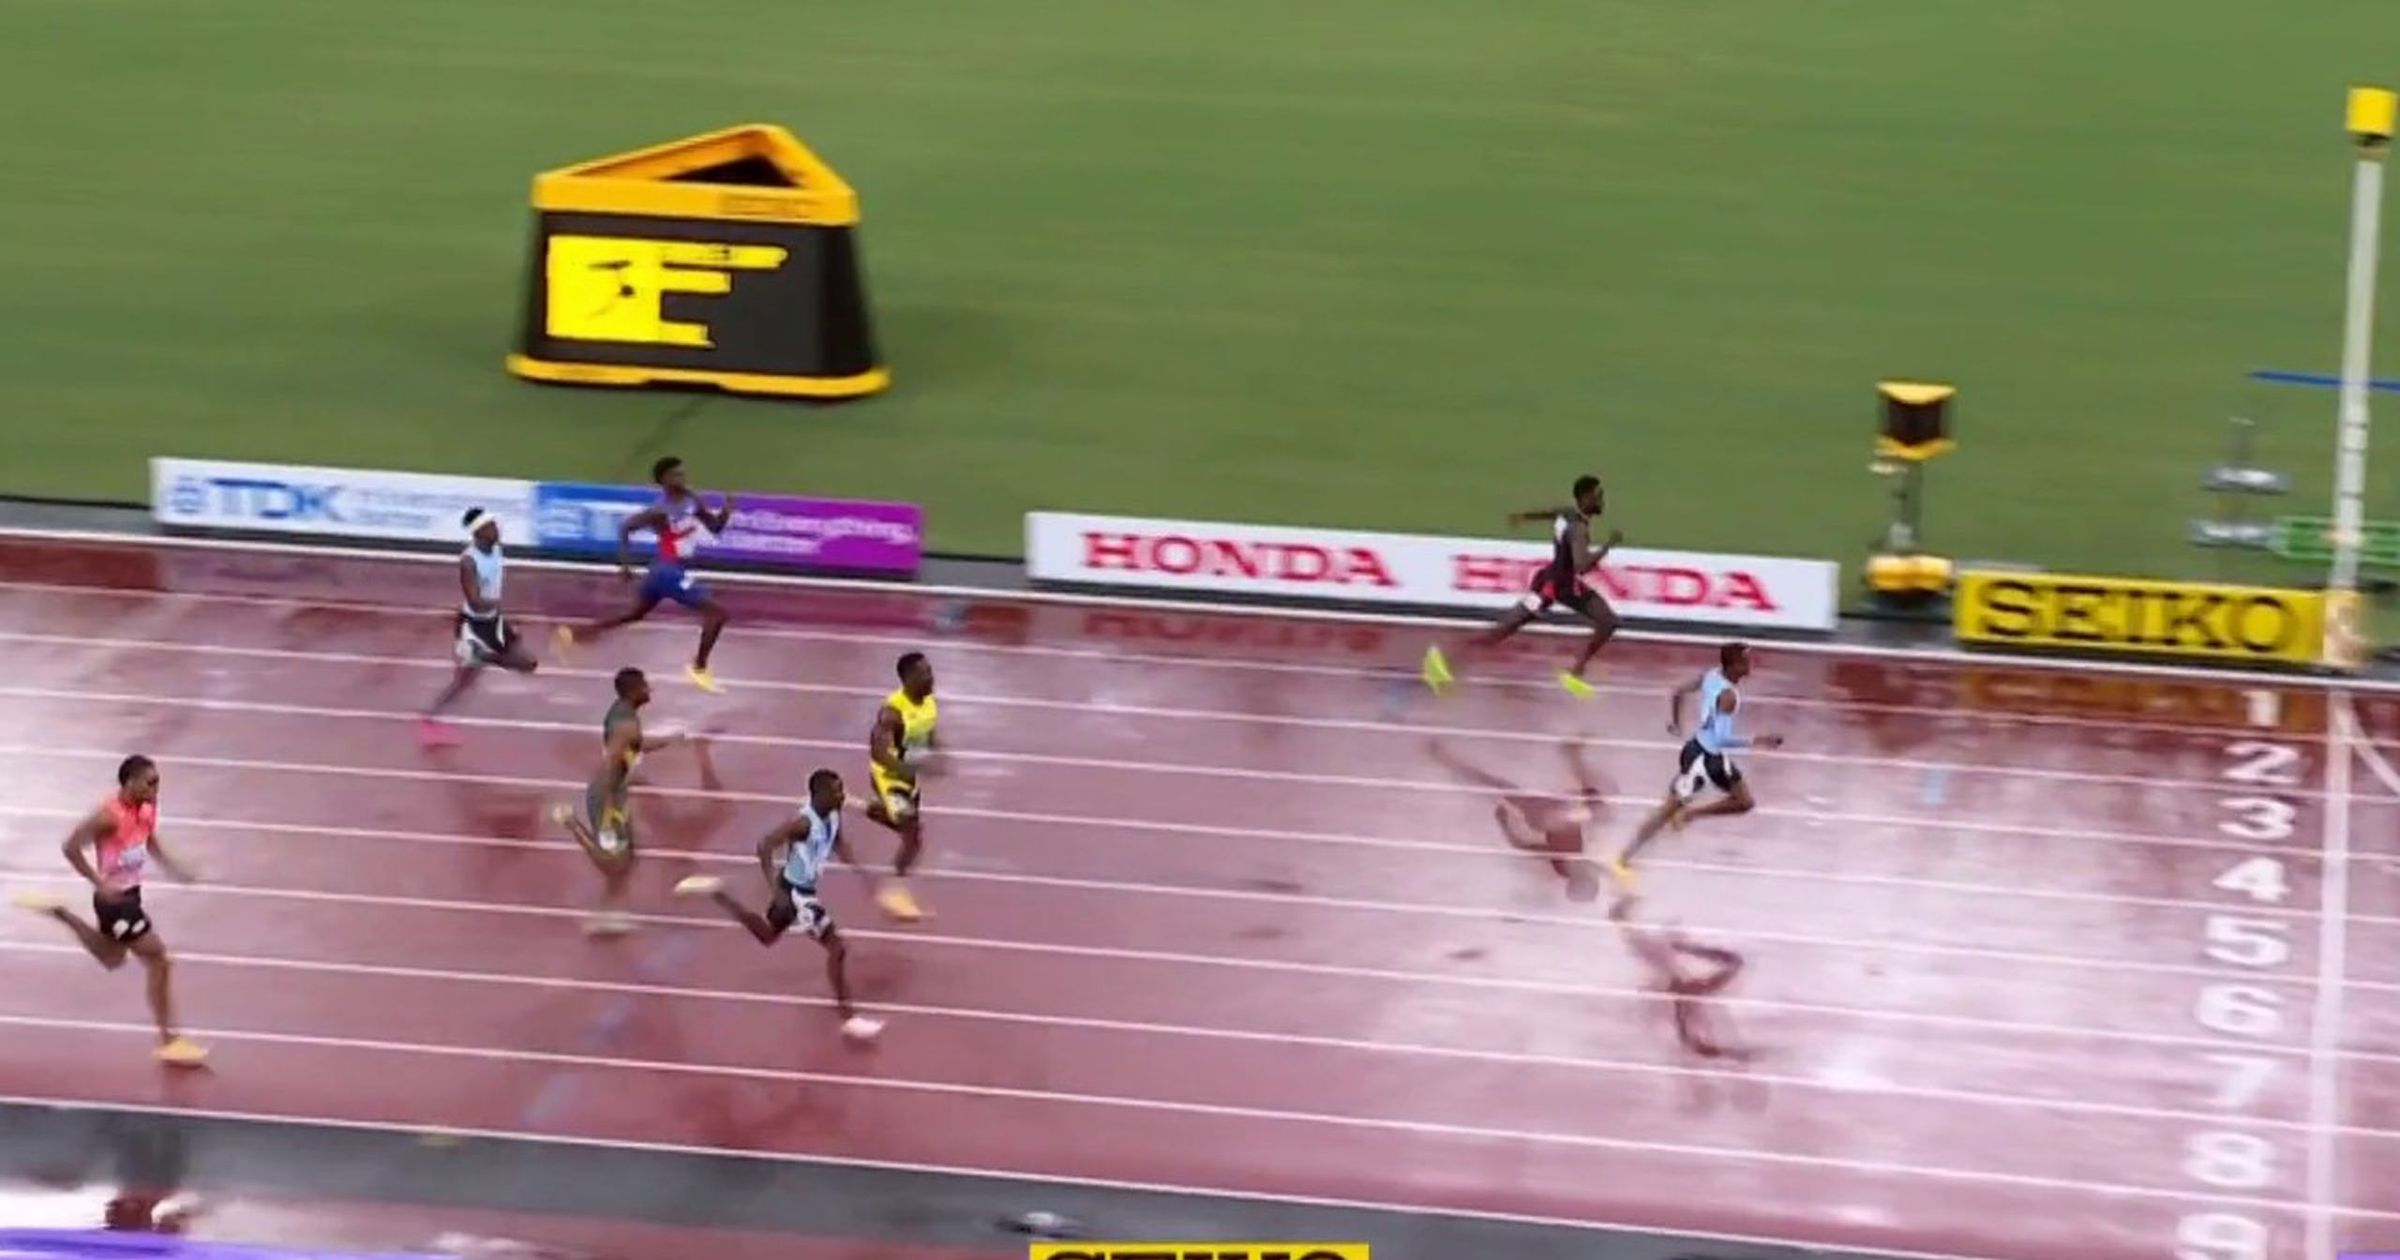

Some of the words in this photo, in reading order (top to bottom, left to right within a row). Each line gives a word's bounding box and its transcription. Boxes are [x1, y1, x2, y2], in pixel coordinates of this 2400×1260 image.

[206, 475, 346, 522] TDK
[1080, 532, 1401, 586] HONDA
[1978, 579, 2293, 652] SEIKO
[2241, 689, 2282, 727] 1
[2223, 740, 2300, 783] 2
[2217, 797, 2296, 839] 3
[2212, 856, 2292, 901] 4
[2204, 914, 2290, 966] 5
[2196, 984, 2285, 1036] 6
[2203, 1053, 2281, 1107] 7
[2185, 1131, 2279, 1188] 8
